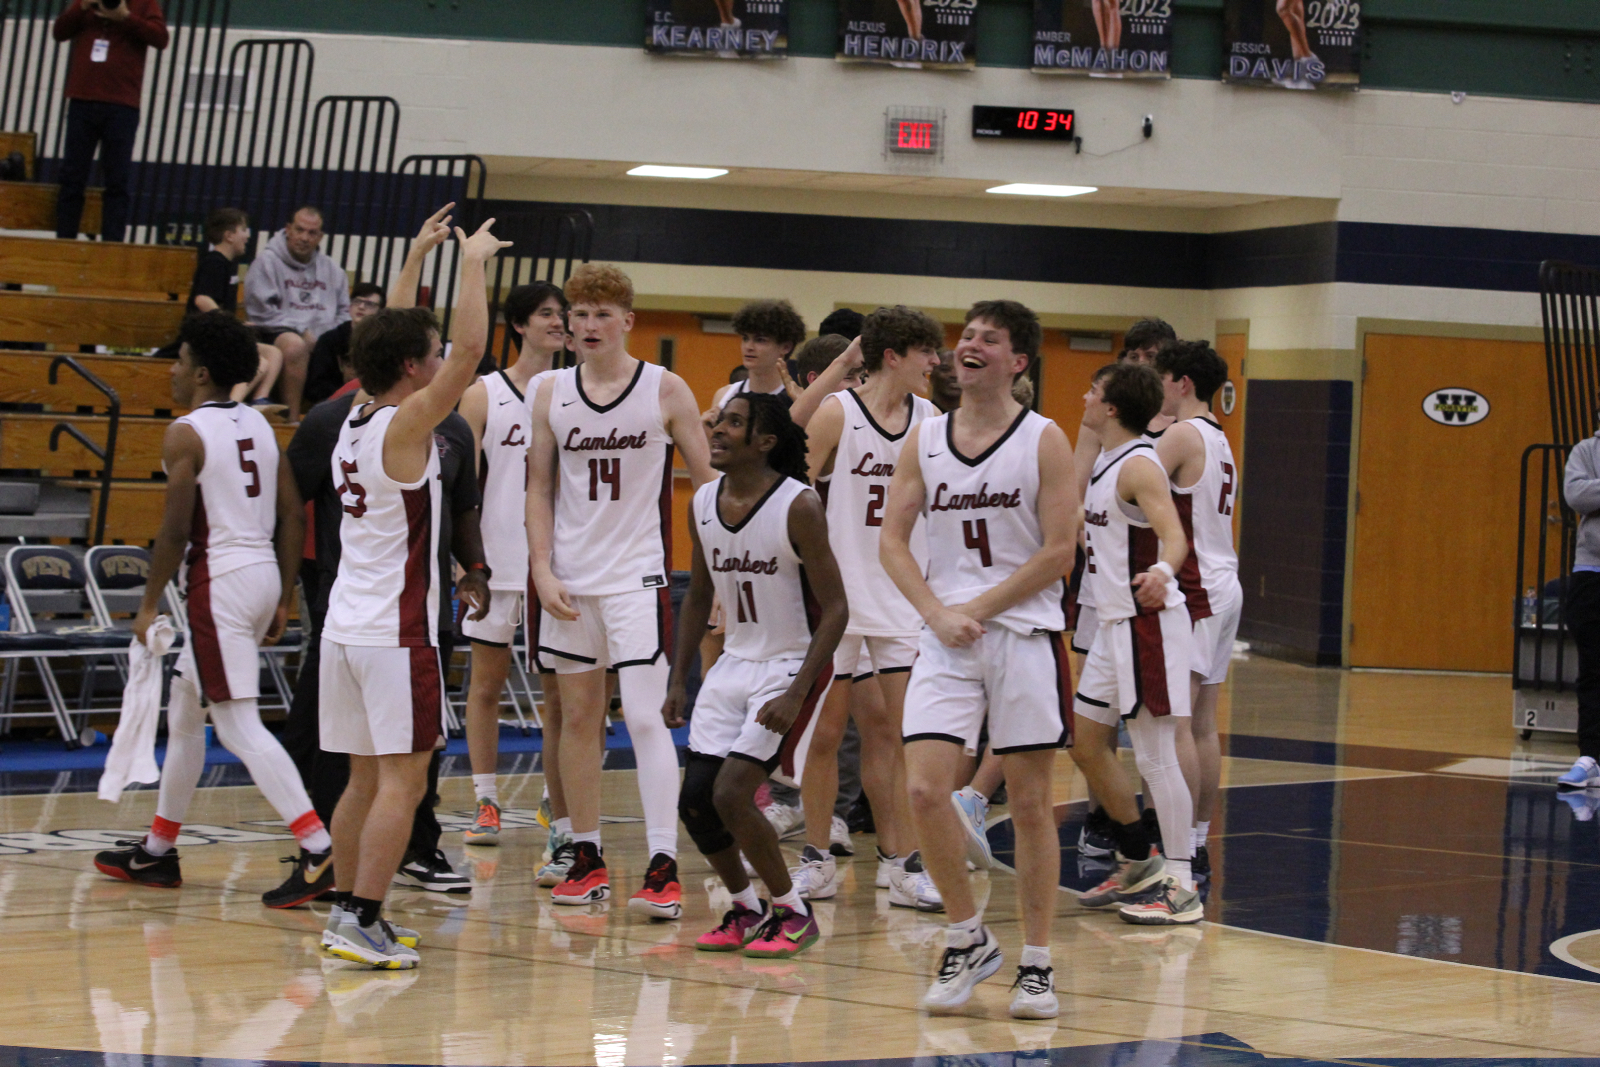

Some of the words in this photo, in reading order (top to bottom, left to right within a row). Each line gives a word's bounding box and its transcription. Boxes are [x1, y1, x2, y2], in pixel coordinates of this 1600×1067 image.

[847, 21, 886, 33] ALEXUS
[1306, 1, 1360, 30] 2023
[652, 24, 778, 51] KEARNEY
[844, 34, 966, 62] HENDRIX
[1035, 31, 1071, 43] AMBER
[1231, 41, 1271, 54] JESSICA
[1034, 44, 1168, 72] McMAHON
[1229, 55, 1326, 82] DAVIS
[898, 121, 934, 149] EXIT
[563, 427, 647, 452] Lambert
[236, 437, 261, 498] 5
[851, 452, 896, 477] Lam
[588, 458, 621, 501] 14
[930, 482, 1021, 512] Lambert
[962, 518, 993, 568] 4
[736, 580, 758, 624] 11
[1527, 710, 1536, 727] 2
